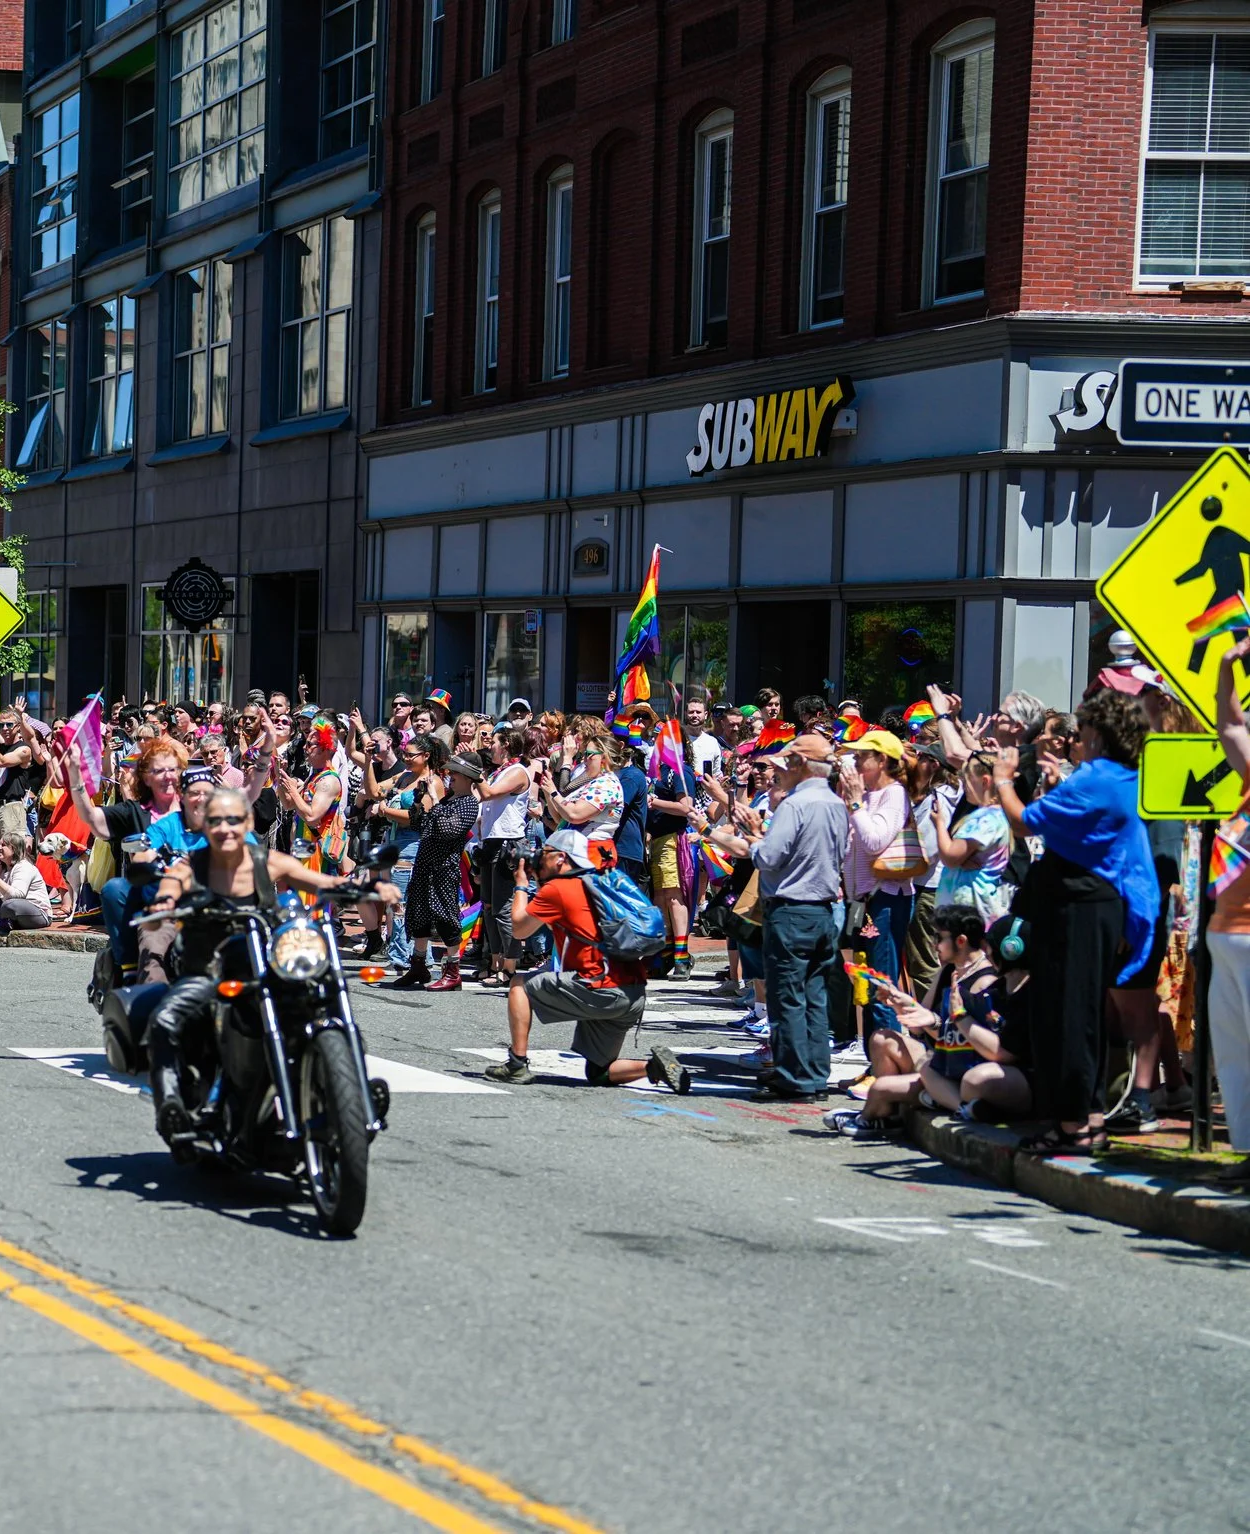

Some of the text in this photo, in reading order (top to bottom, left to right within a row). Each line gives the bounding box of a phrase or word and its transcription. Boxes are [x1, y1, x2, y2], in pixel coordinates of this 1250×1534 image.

[1144, 387, 1201, 418] ONE
[1213, 389, 1250, 420] WA
[685, 376, 844, 476] SUBWAY
[584, 548, 599, 564] 496
[586, 684, 610, 693] LOITERIN
